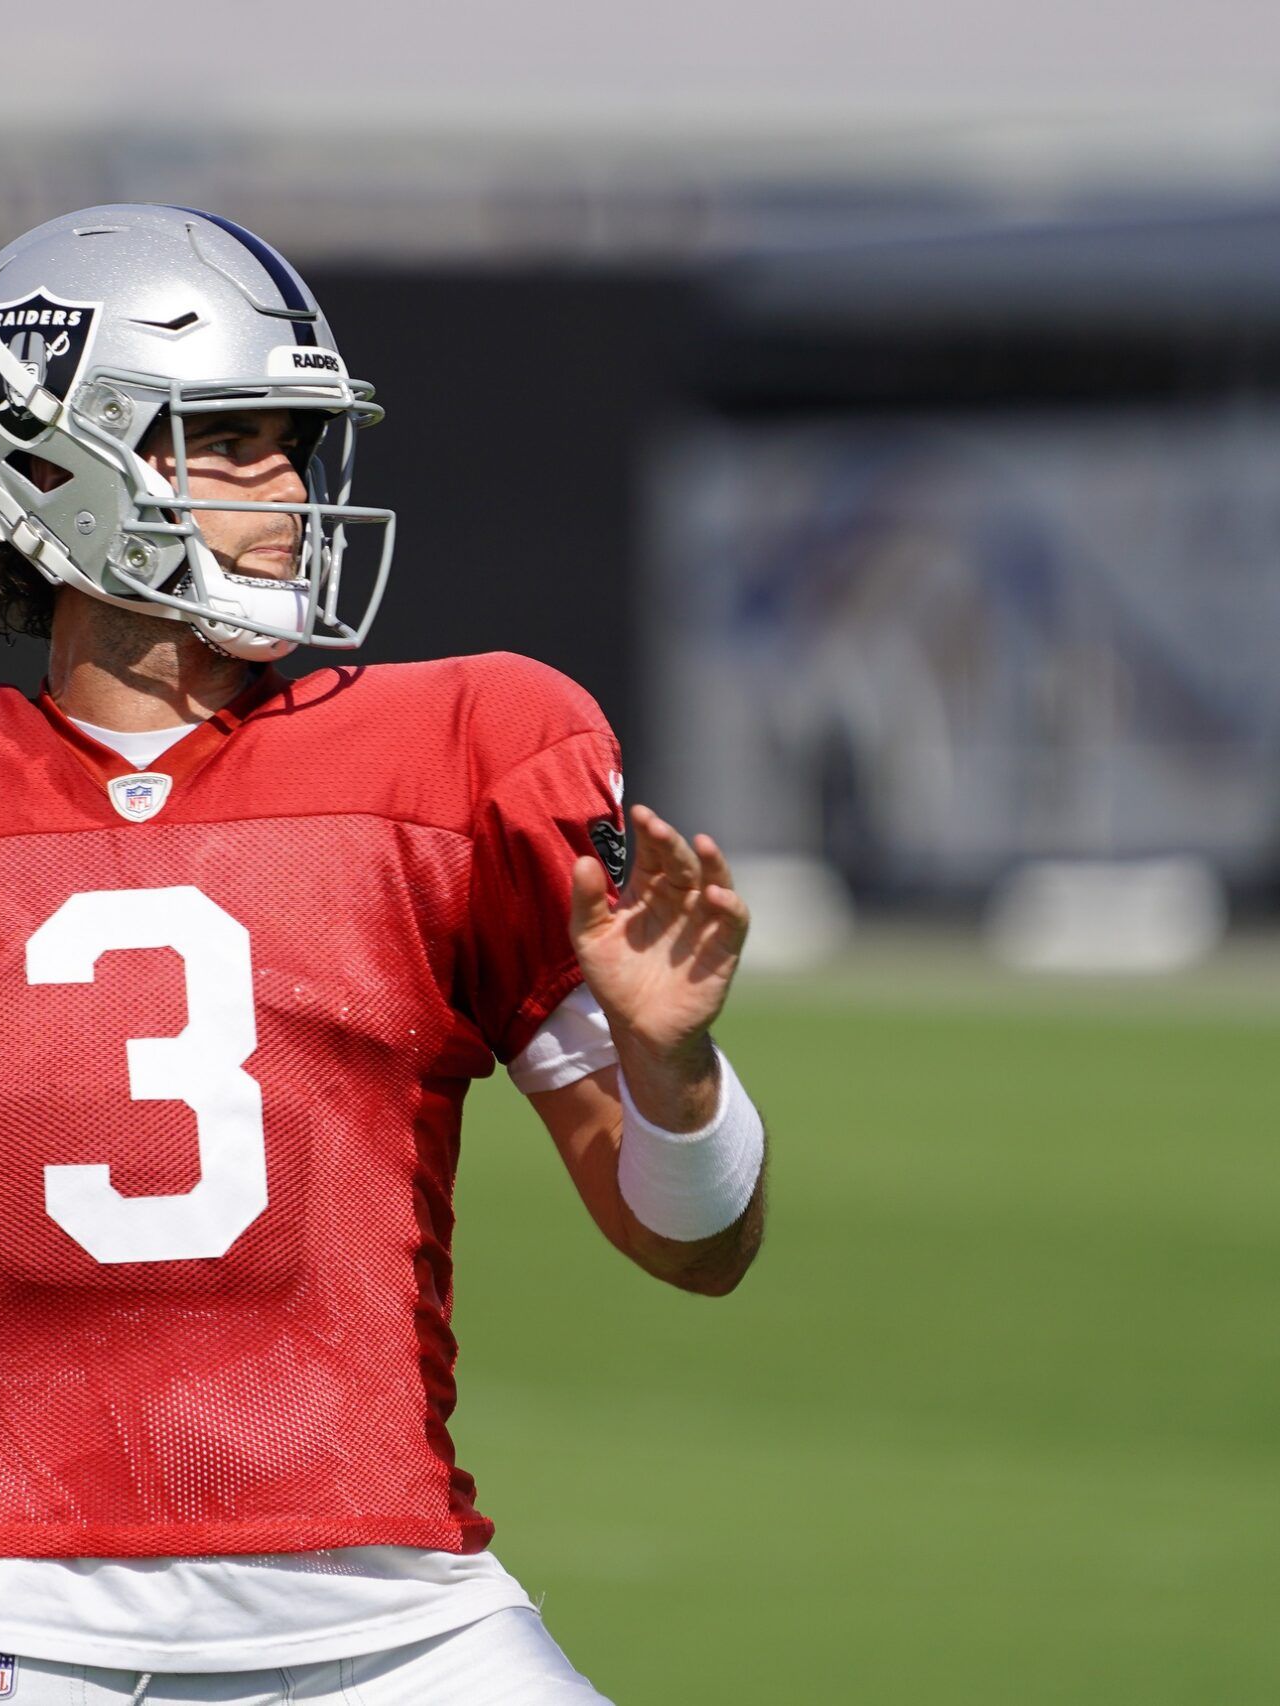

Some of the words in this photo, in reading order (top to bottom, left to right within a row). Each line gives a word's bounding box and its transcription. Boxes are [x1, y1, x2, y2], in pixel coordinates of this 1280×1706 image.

[292, 353, 339, 372] RAIDERS
[128, 797, 151, 809] NFL
[26, 885, 269, 1264] 3
